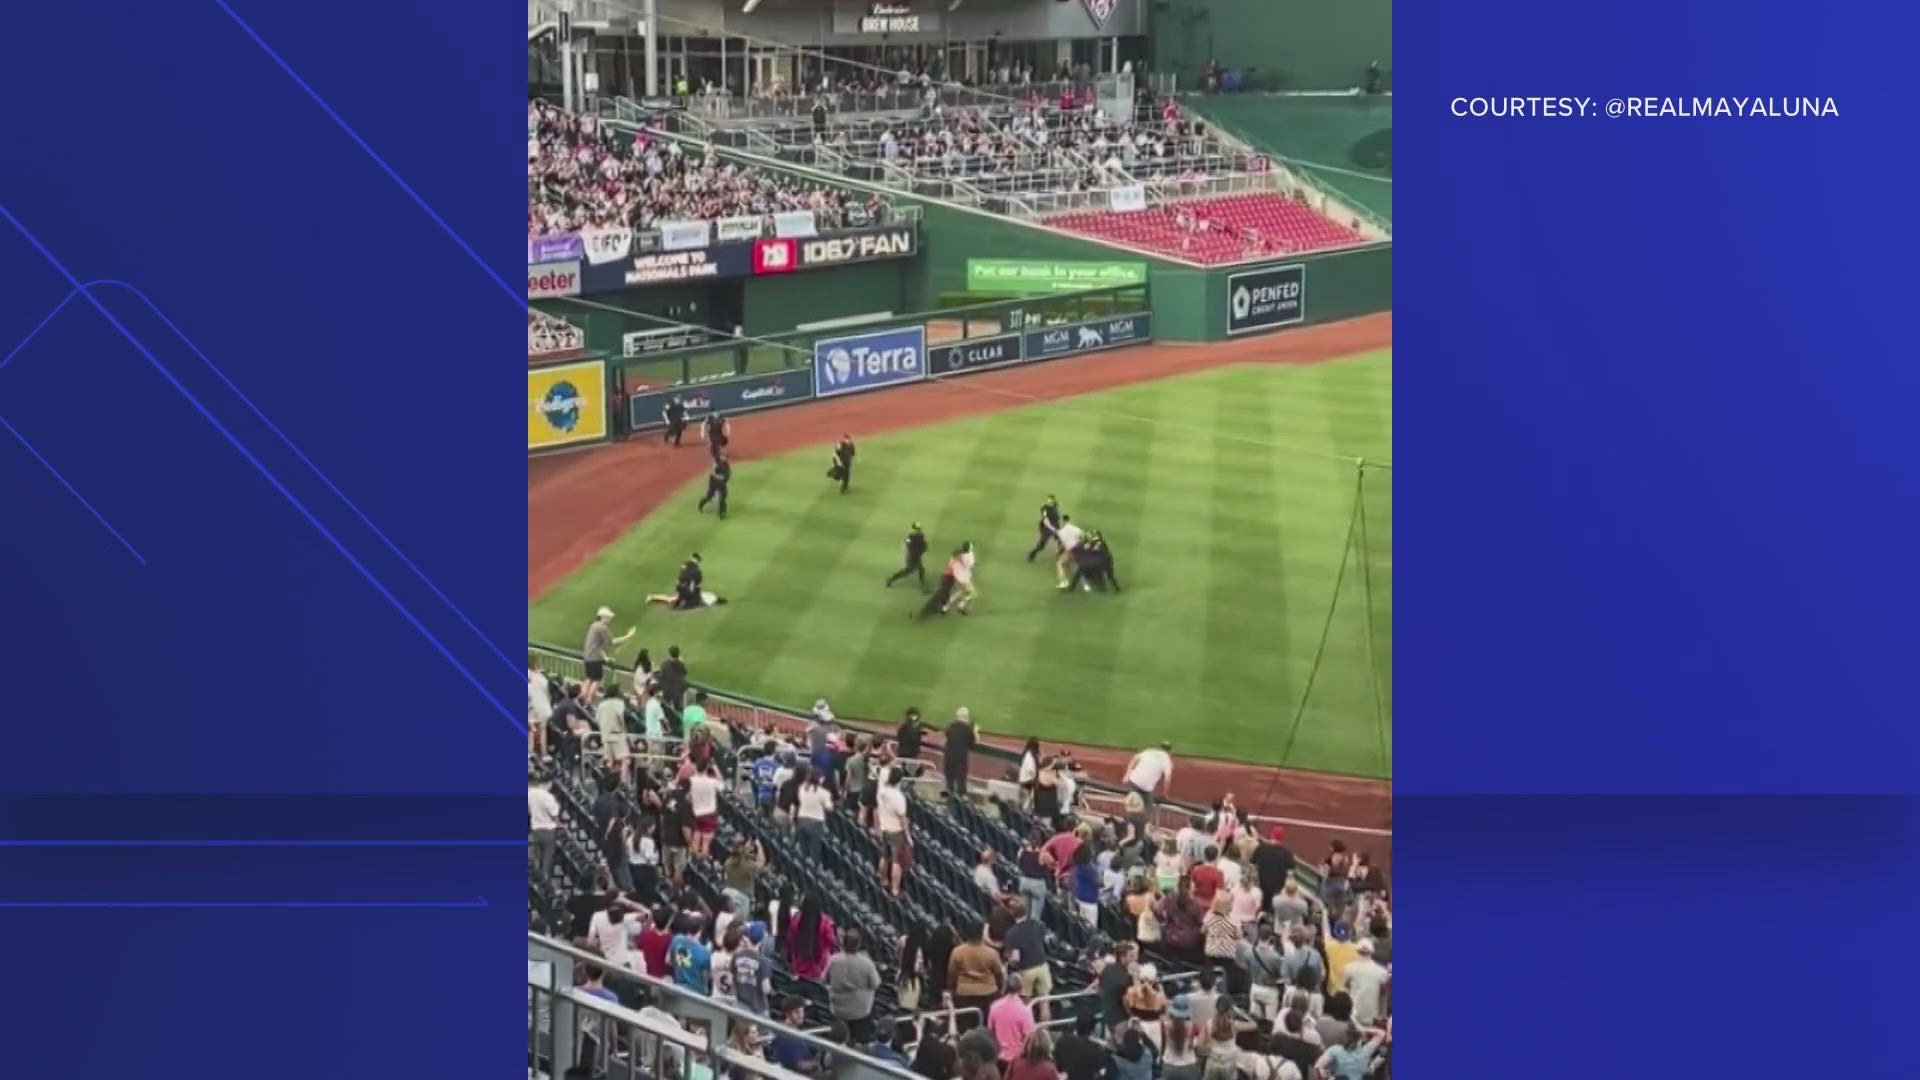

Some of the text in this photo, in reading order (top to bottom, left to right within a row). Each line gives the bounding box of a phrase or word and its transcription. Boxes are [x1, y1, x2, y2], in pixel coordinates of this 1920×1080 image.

[861, 232, 910, 257] FAN
[1252, 282, 1299, 304] PENFED
[1109, 319, 1135, 334] MGM
[852, 346, 917, 377] Terra
[968, 345, 1004, 362] CLEAR
